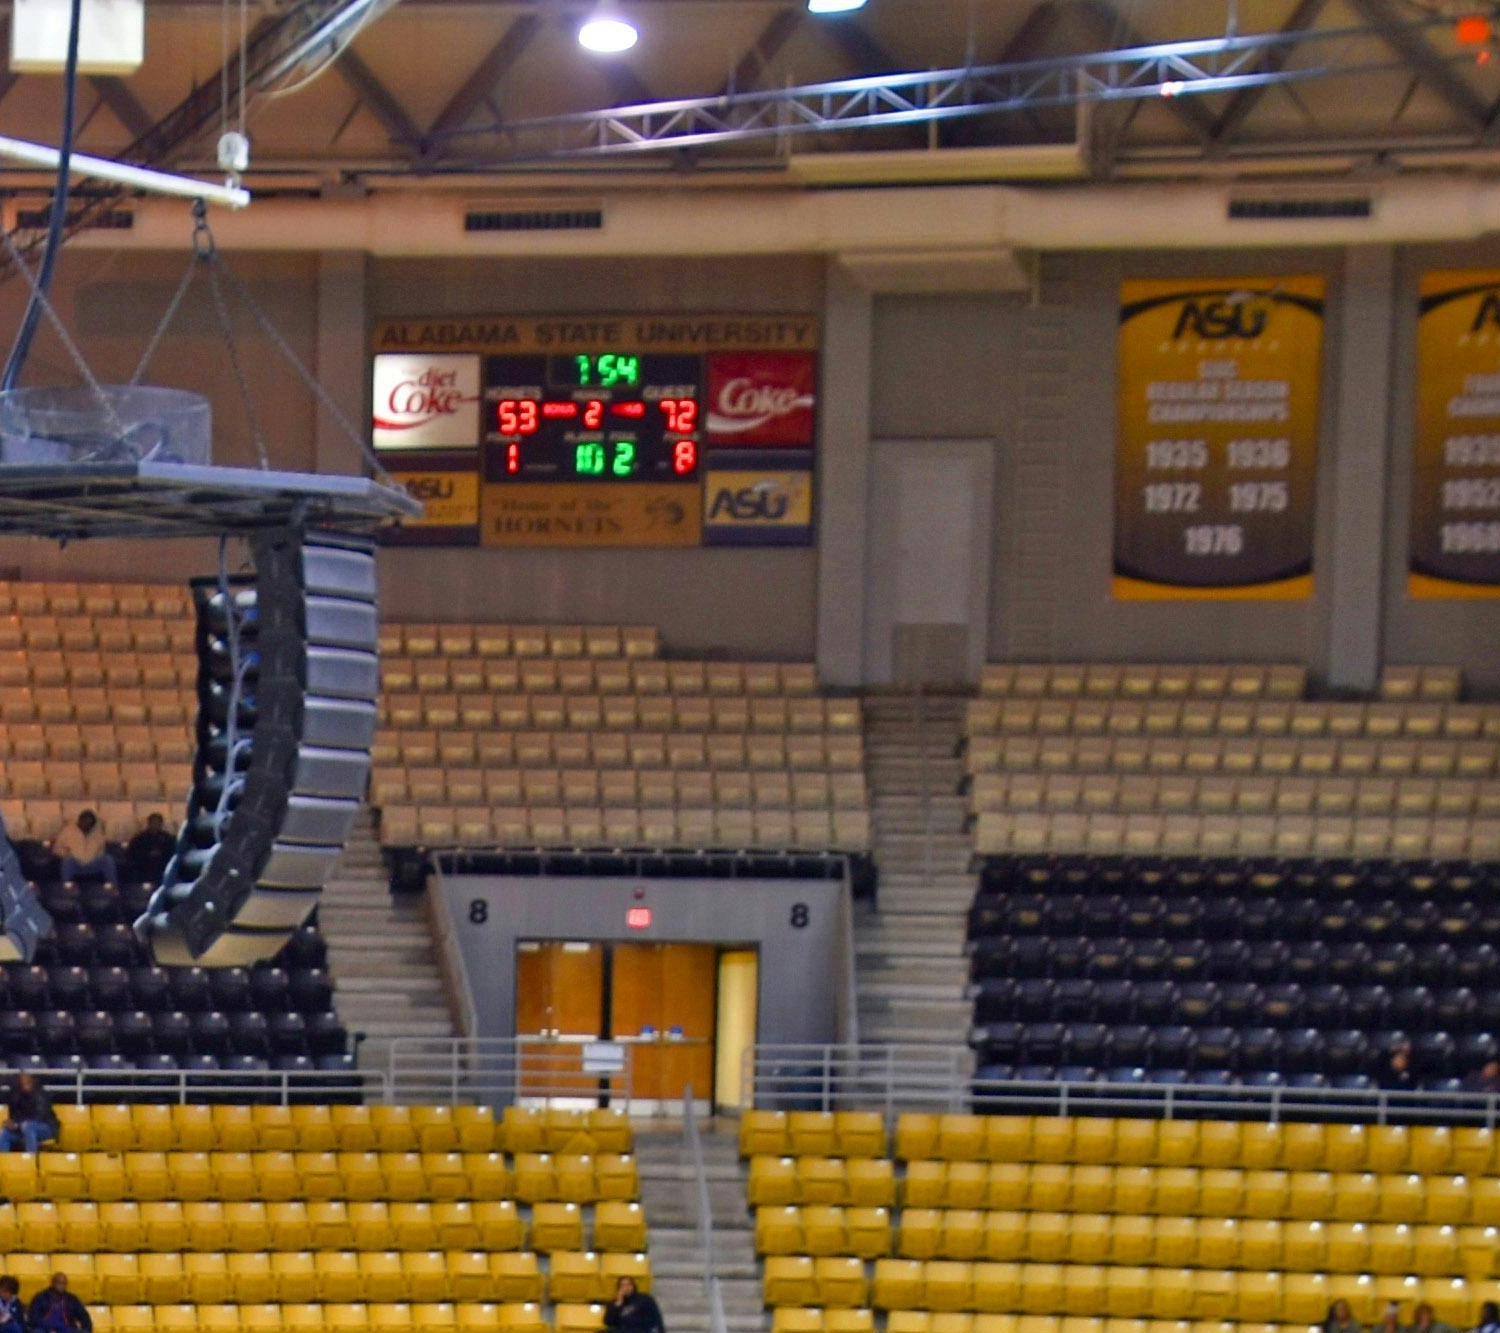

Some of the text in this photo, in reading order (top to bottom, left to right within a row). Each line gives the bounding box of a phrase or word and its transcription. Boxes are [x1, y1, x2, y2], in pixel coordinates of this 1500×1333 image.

[382, 321, 811, 346] ALABAMA STATE UNIVERSITY
[1173, 302, 1268, 341] ASU
[418, 366, 459, 387] diet
[388, 380, 465, 415] Coke
[718, 377, 799, 416] Coke
[499, 399, 538, 434] 53
[583, 400, 603, 430] 2
[659, 399, 698, 433] 72
[611, 441, 636, 476] 2
[709, 486, 789, 520] ASU
[468, 898, 489, 925] 8
[789, 903, 810, 929] 8
